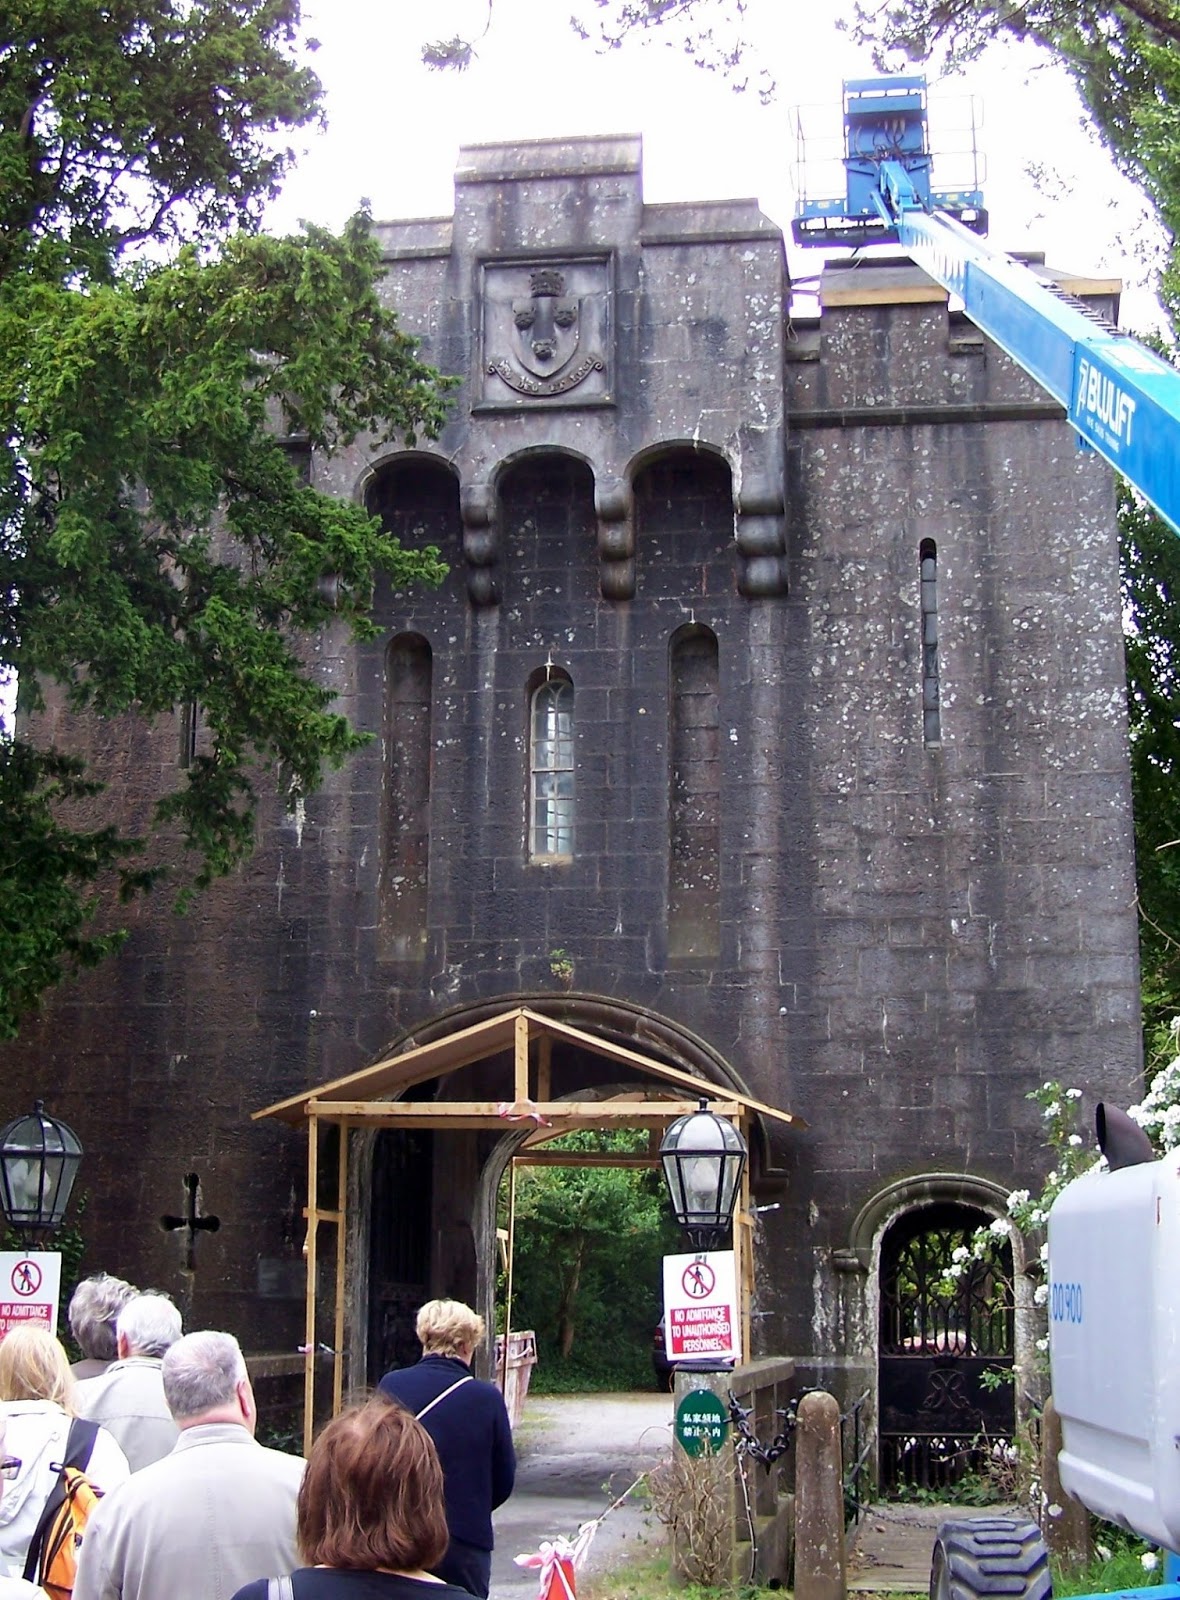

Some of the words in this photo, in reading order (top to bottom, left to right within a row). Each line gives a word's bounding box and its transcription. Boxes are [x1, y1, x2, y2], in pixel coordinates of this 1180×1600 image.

[2, 1304, 11, 1316] NO
[11, 1305, 48, 1318] ADMITTANCE
[674, 1310, 685, 1323] NO
[686, 1306, 726, 1322] ADMITTANCE
[672, 1325, 681, 1338] TO
[682, 1321, 731, 1337] UNAUTHORISED
[683, 1339, 722, 1352] PERSONNEL
